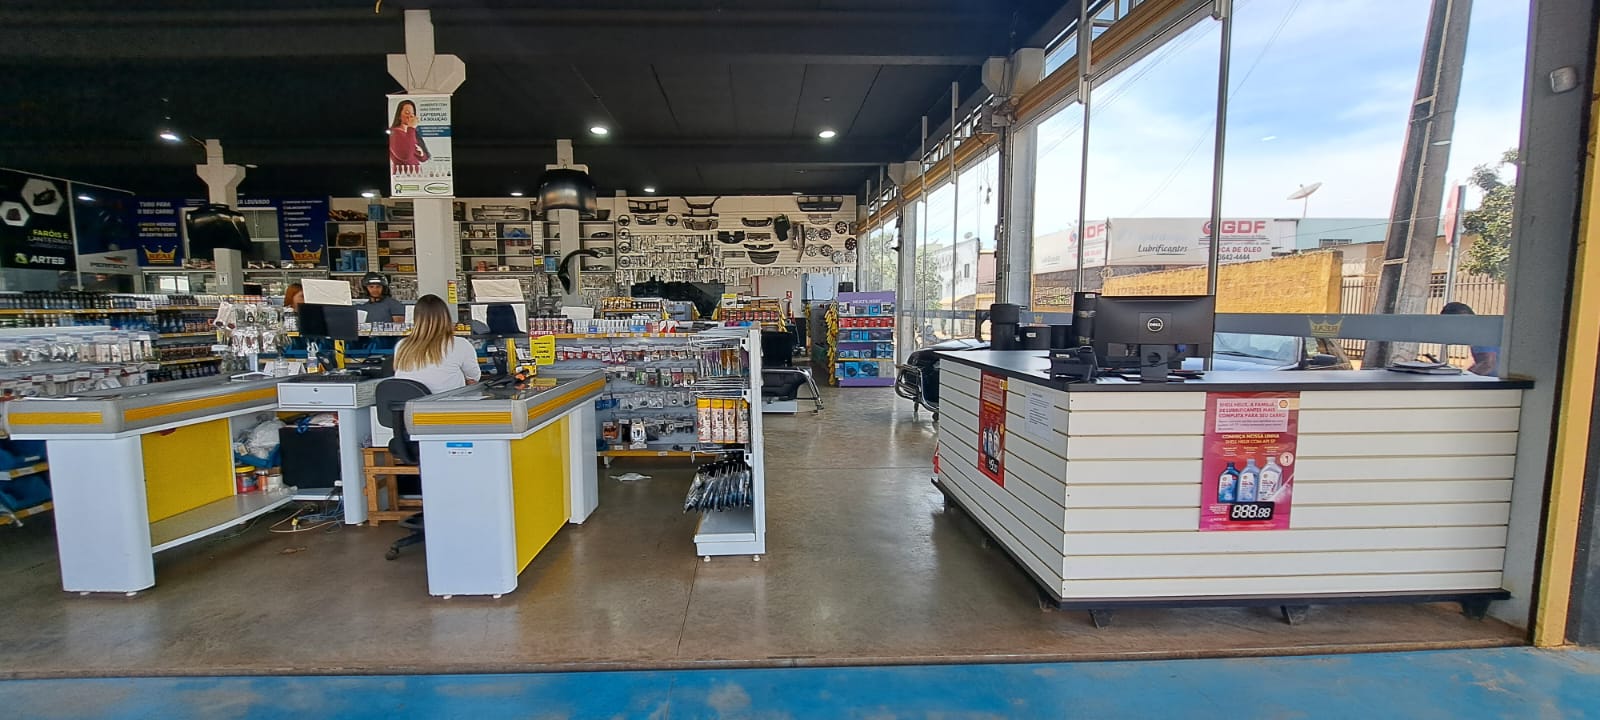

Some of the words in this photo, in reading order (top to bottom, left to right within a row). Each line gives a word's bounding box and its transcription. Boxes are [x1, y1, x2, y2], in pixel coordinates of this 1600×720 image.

[1084, 224, 1105, 239] DF
[1221, 221, 1266, 234] GDF
[33, 229, 62, 238] FARÓIS
[1138, 244, 1188, 254] Lubrificantes
[30, 255, 66, 265] ARTEB
